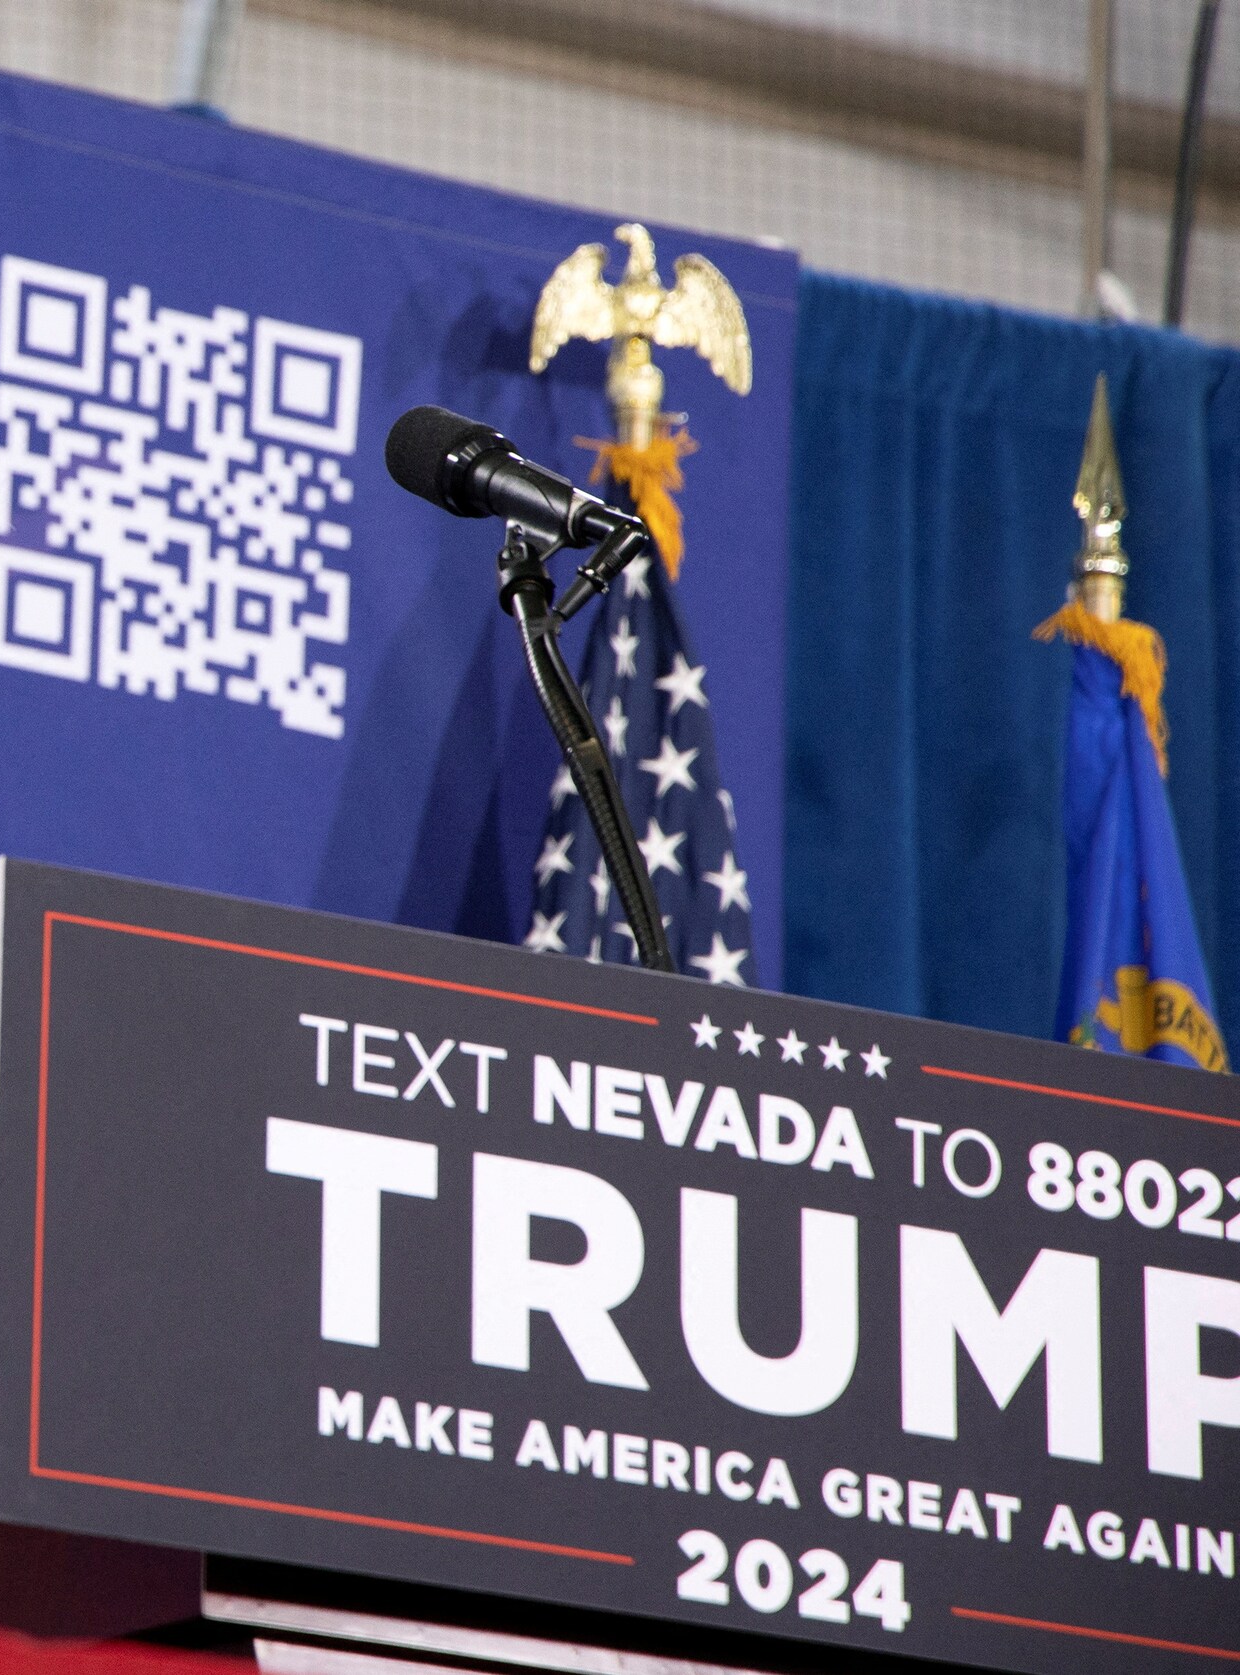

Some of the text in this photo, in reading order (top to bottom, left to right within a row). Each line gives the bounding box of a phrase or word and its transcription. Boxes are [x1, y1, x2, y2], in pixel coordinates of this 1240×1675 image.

[299, 1012, 508, 1114] TEXT
[533, 1054, 875, 1180] NEVADA
[895, 1116, 1003, 1199] TO
[265, 1116, 1240, 1480] TRUMP
[318, 1386, 494, 1461] MAKE
[516, 1420, 800, 1510] AMERICA
[822, 1468, 1022, 1542] GREAT
[677, 1530, 911, 1632] 2024
